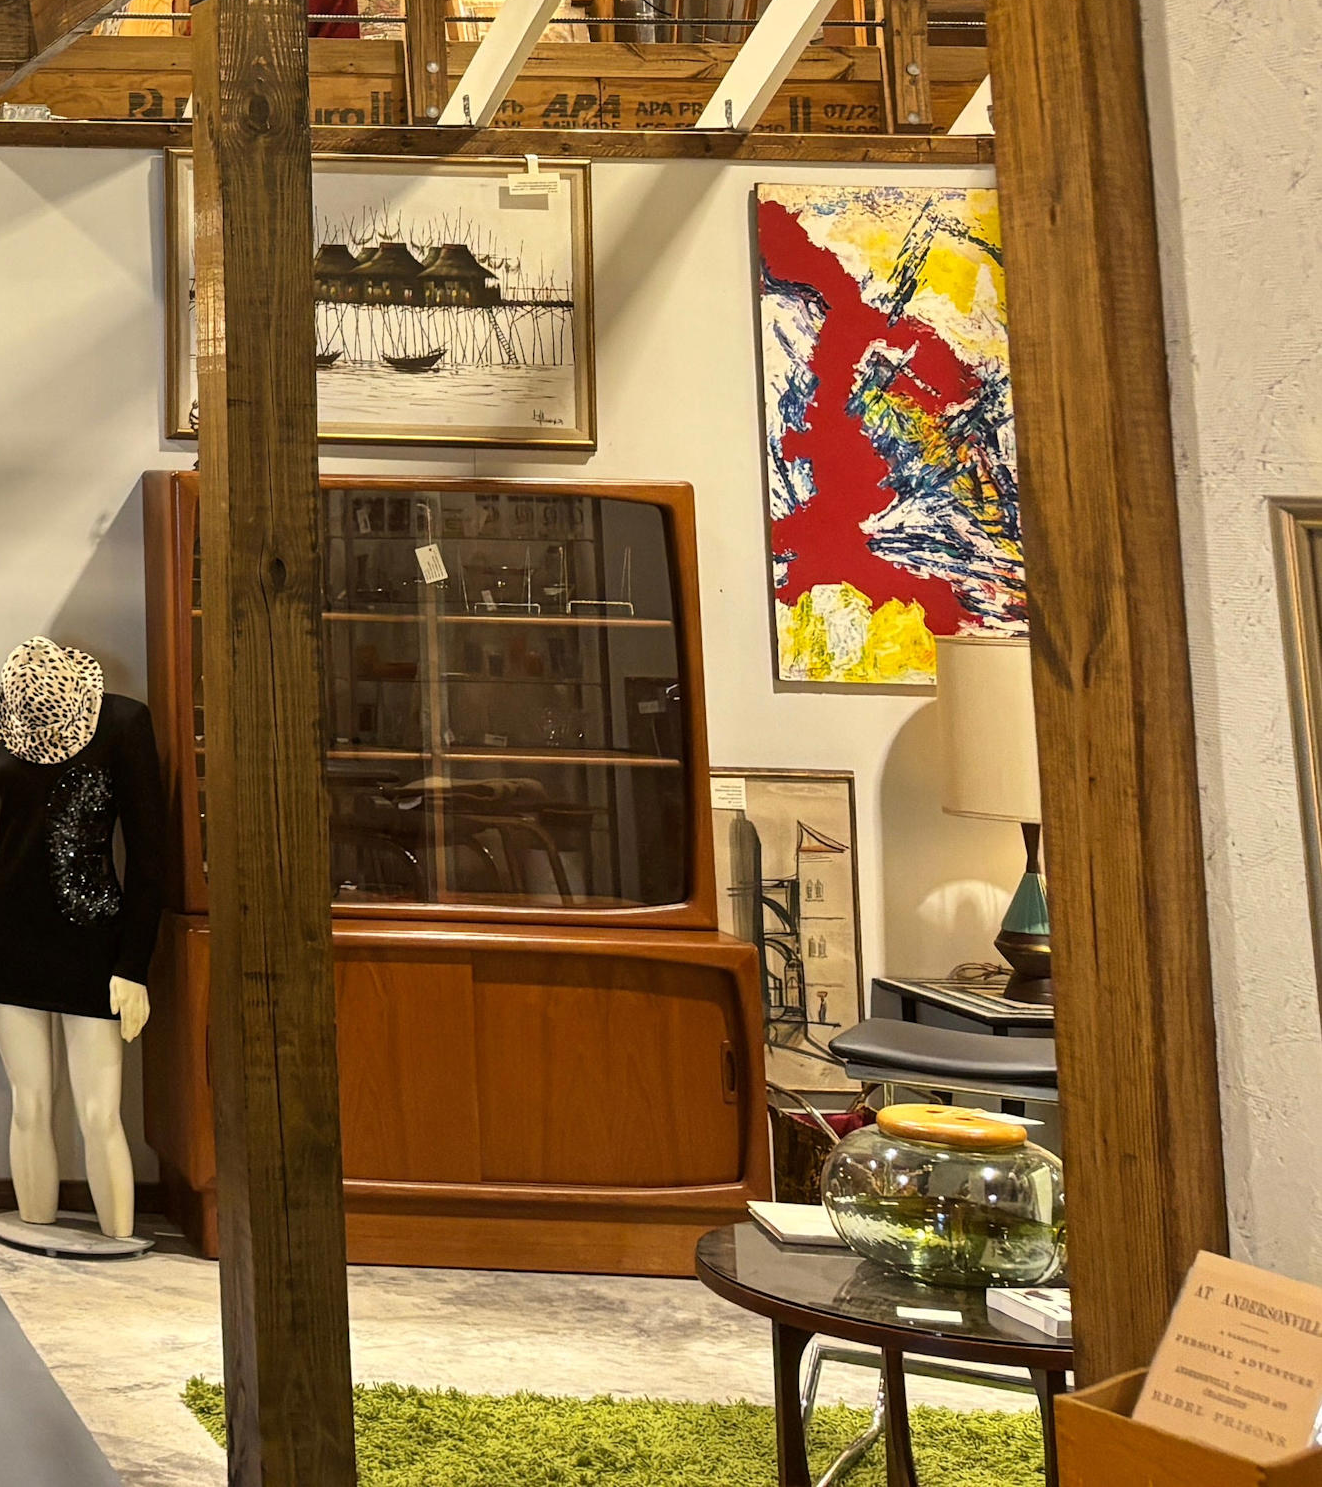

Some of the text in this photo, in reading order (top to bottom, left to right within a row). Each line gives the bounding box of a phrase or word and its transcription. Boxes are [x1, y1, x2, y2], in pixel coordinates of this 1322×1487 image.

[540, 94, 621, 118] APA
[635, 101, 673, 116] APA
[1194, 1284, 1214, 1301] AT
[1175, 1333, 1234, 1360] PERSONAL
[1240, 1357, 1314, 1388] ADVENTURE
[1151, 1389, 1205, 1417] REBEL
[1212, 1412, 1288, 1448] PRISONS
